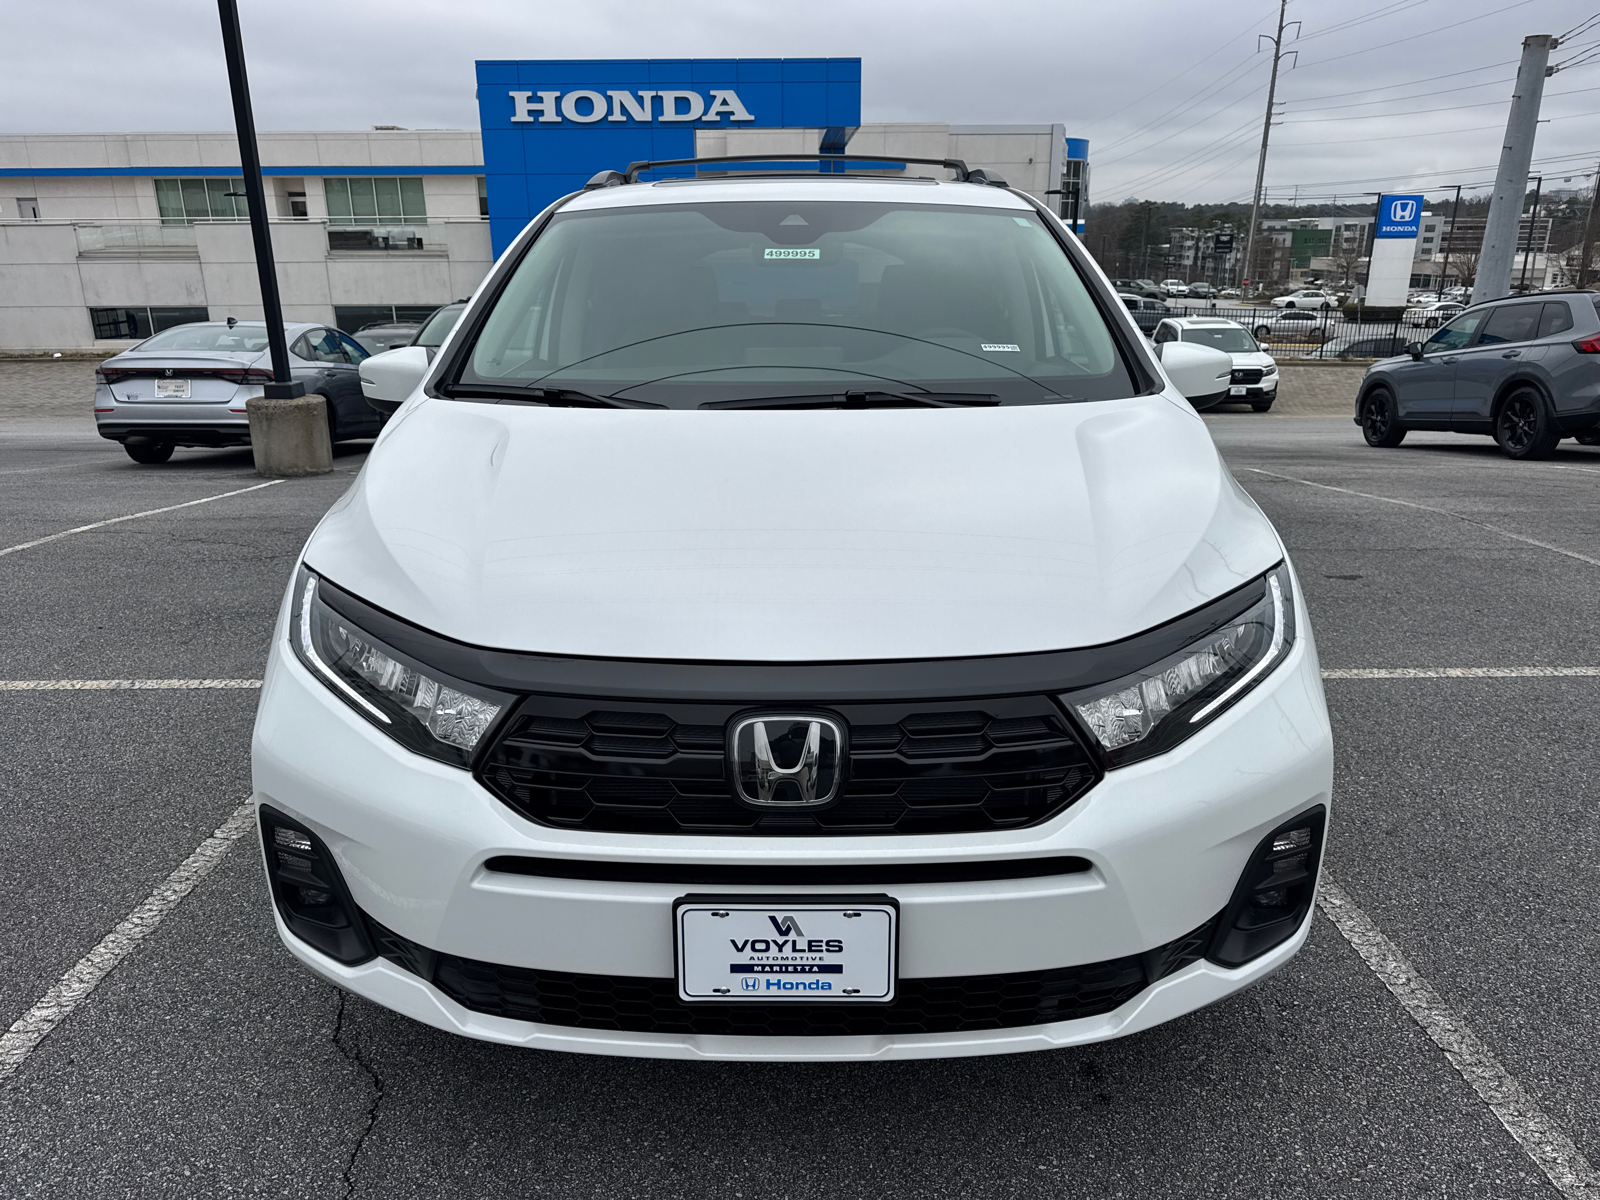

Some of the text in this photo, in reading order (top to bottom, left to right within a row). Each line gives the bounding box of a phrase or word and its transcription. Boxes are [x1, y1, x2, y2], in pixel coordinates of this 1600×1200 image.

[508, 90, 755, 122] HONDA
[765, 250, 816, 258] 499995
[729, 939, 844, 953] VOYLES
[765, 978, 833, 991] Honda
